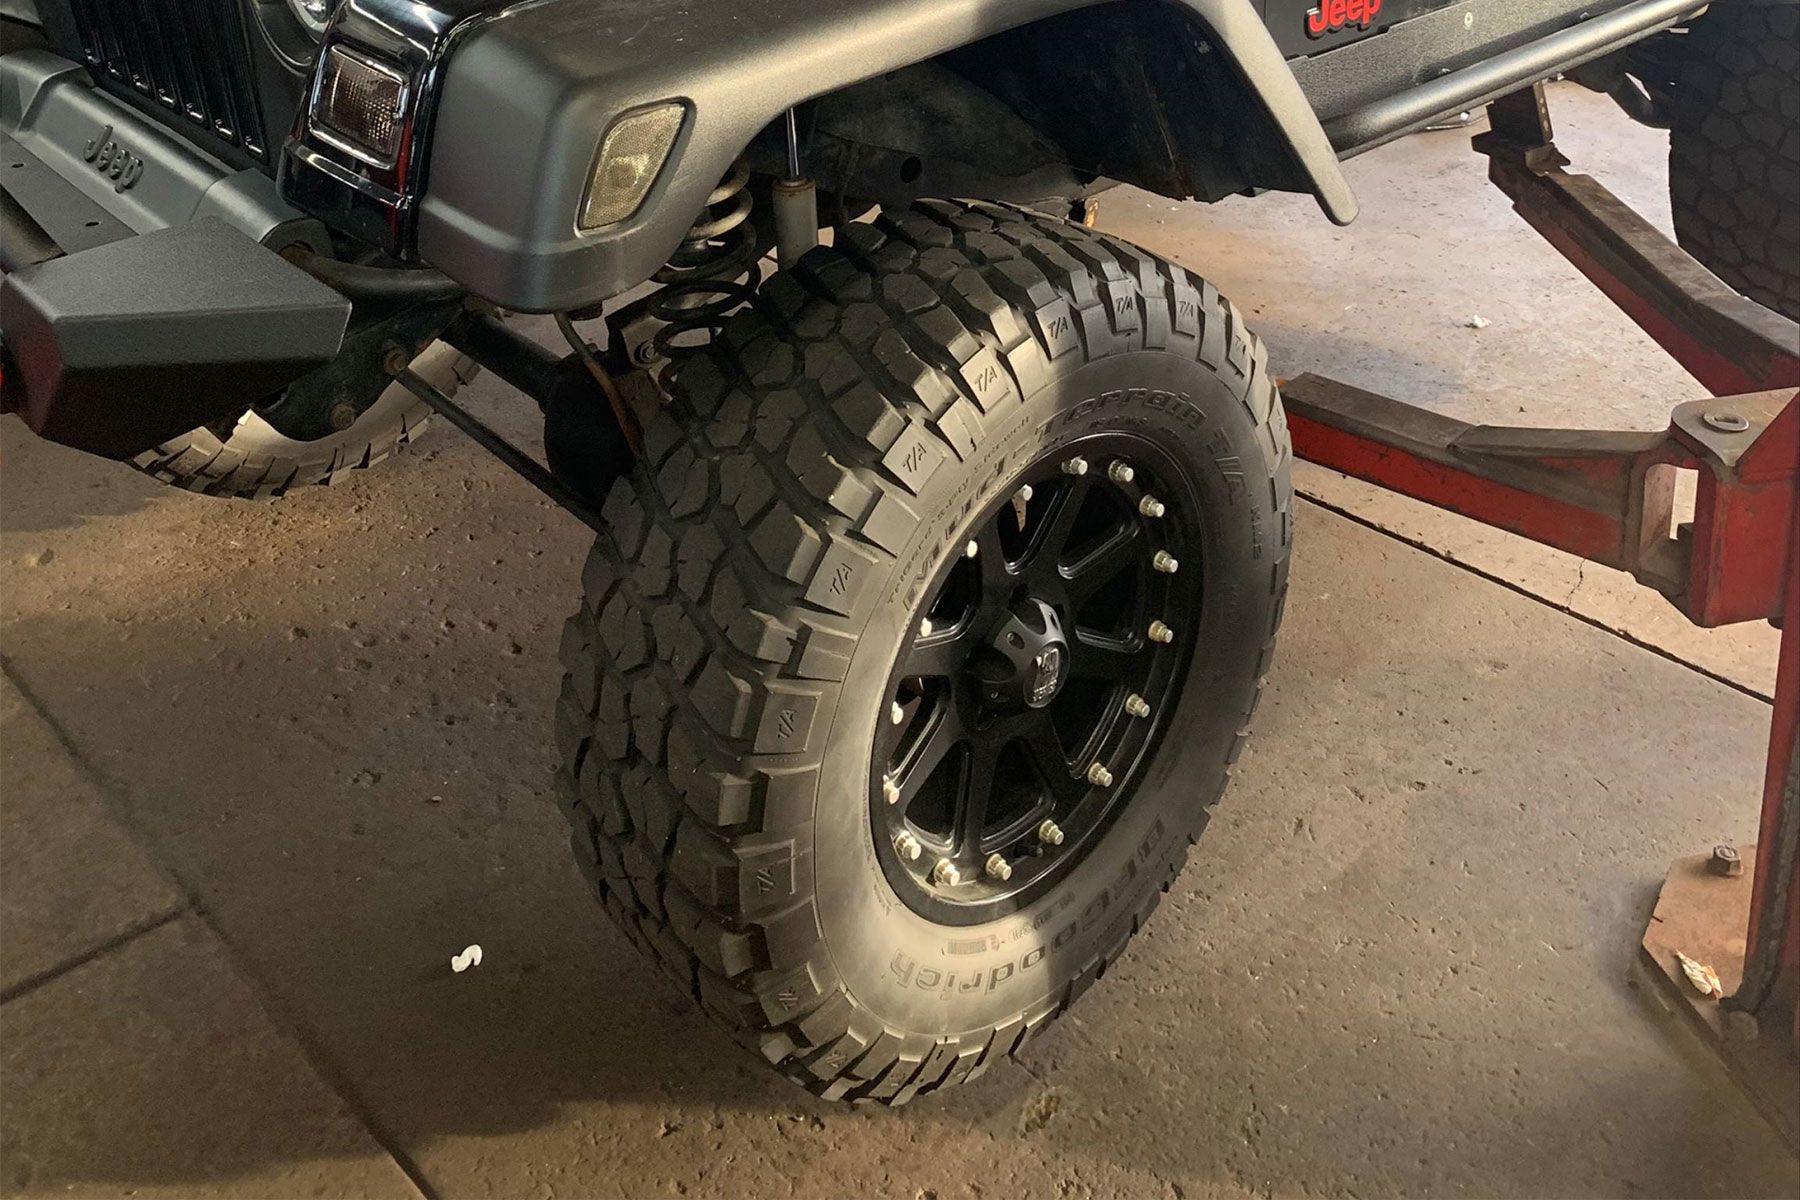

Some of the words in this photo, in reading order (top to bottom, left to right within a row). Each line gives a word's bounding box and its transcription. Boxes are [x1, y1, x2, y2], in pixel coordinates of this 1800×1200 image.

[84, 125, 144, 194] Jeep
[1115, 295, 1134, 315] T/A
[1178, 300, 1195, 319] T/A
[1047, 316, 1070, 341] T/A
[974, 364, 998, 393] T/A
[902, 441, 928, 474] T/A
[828, 561, 854, 596] T/A
[777, 706, 798, 741] T/A
